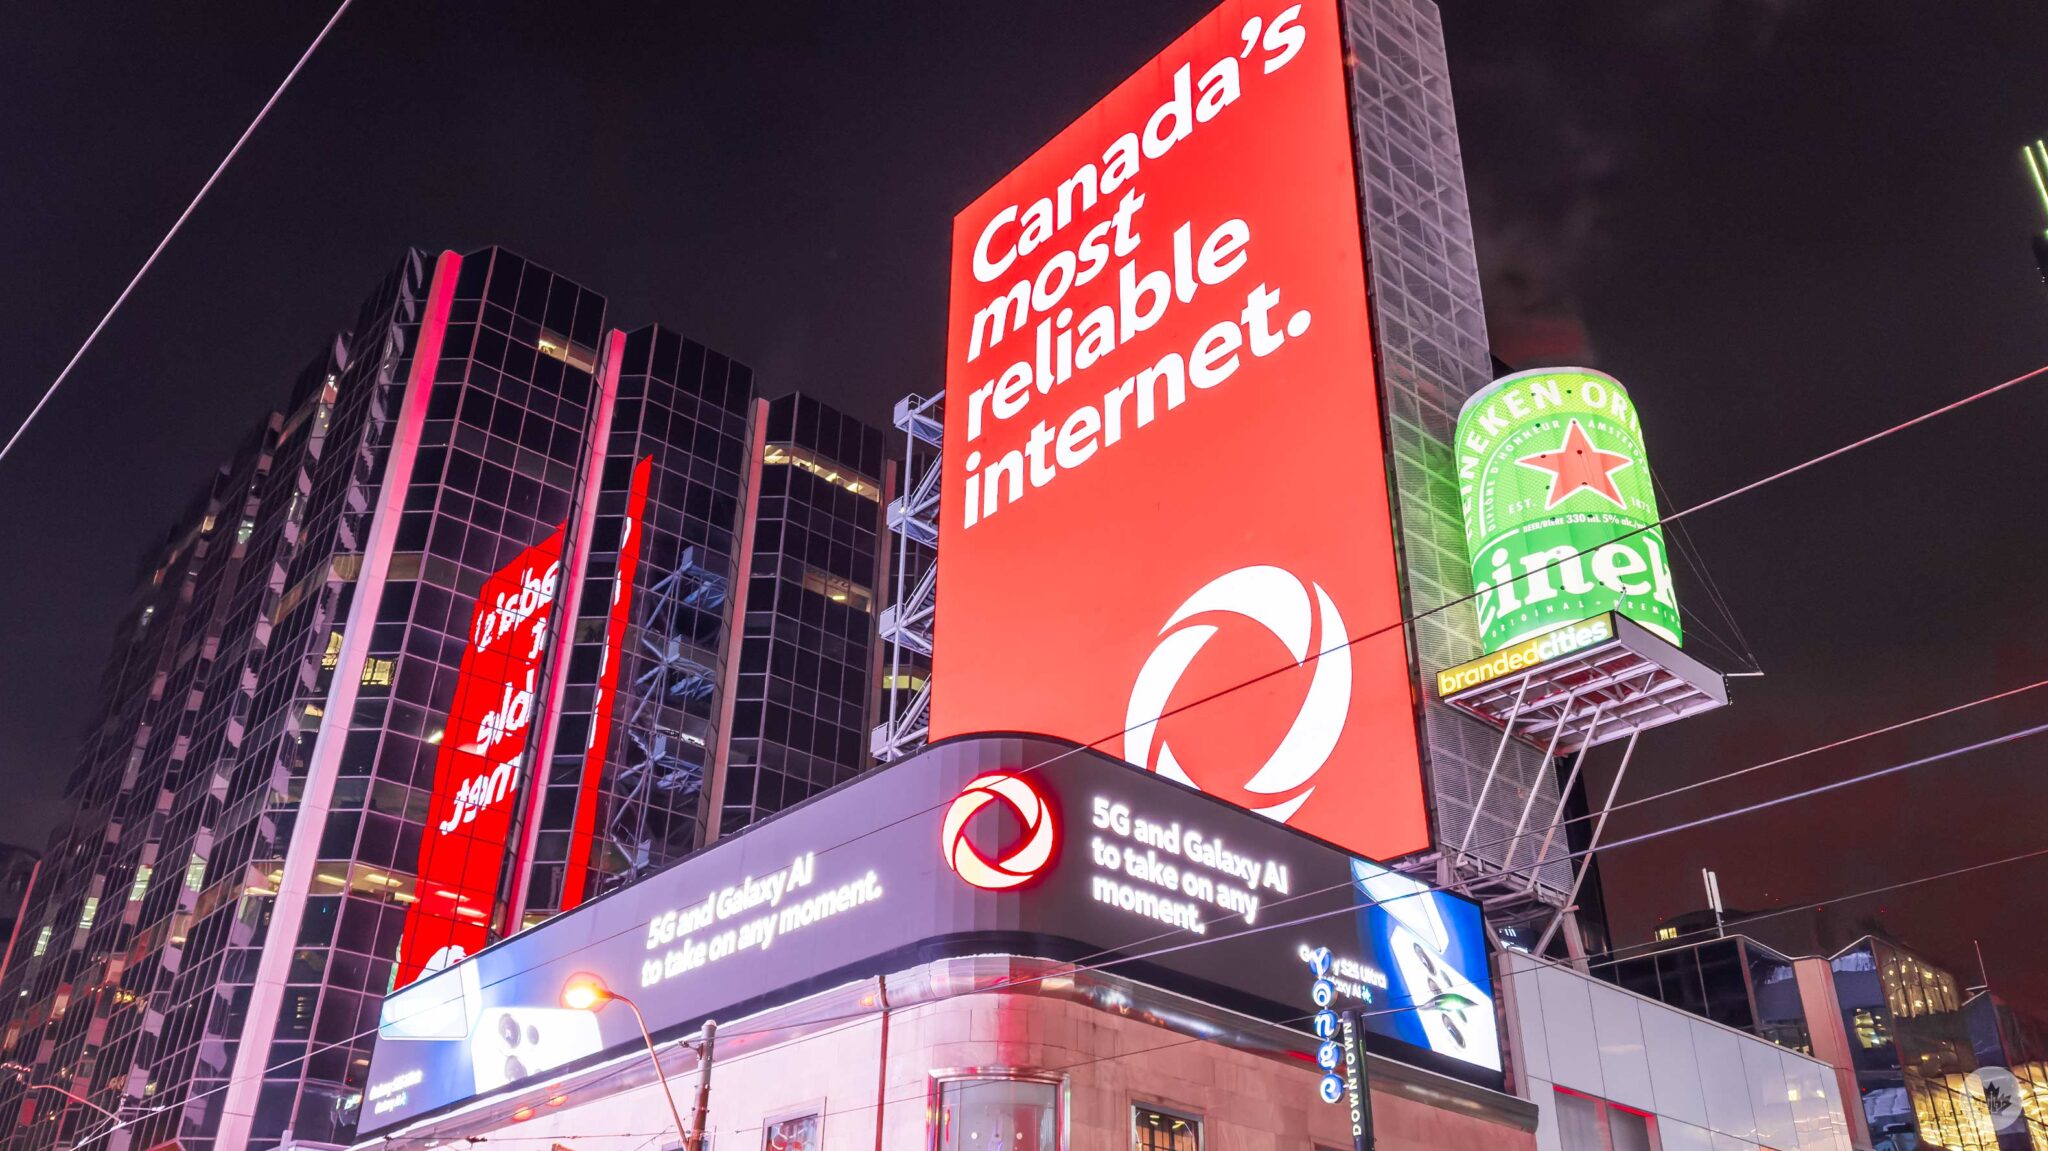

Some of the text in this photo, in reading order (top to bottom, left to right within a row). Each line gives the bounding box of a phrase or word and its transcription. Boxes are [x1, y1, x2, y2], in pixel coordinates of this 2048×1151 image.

[972, 4, 1306, 283] Canada's
[967, 187, 1145, 364] most
[967, 218, 1250, 442] reliable
[964, 282, 1311, 529] internet.
[1508, 498, 1537, 514] EST.
[1566, 513, 1586, 524] 330
[1602, 513, 1620, 524] 5%
[1440, 620, 1608, 693] brandedcities
[1092, 836, 1258, 925] to take on any
[1093, 797, 1288, 895] 5G and Galaxy AI
[641, 870, 883, 987] to take on any moment.
[647, 851, 814, 949] 5G and Galaxy AI
[1092, 876, 1206, 934] moment.
[1309, 946, 1343, 1102] Yonge
[1342, 1021, 1362, 1137] DOWNTOWN
